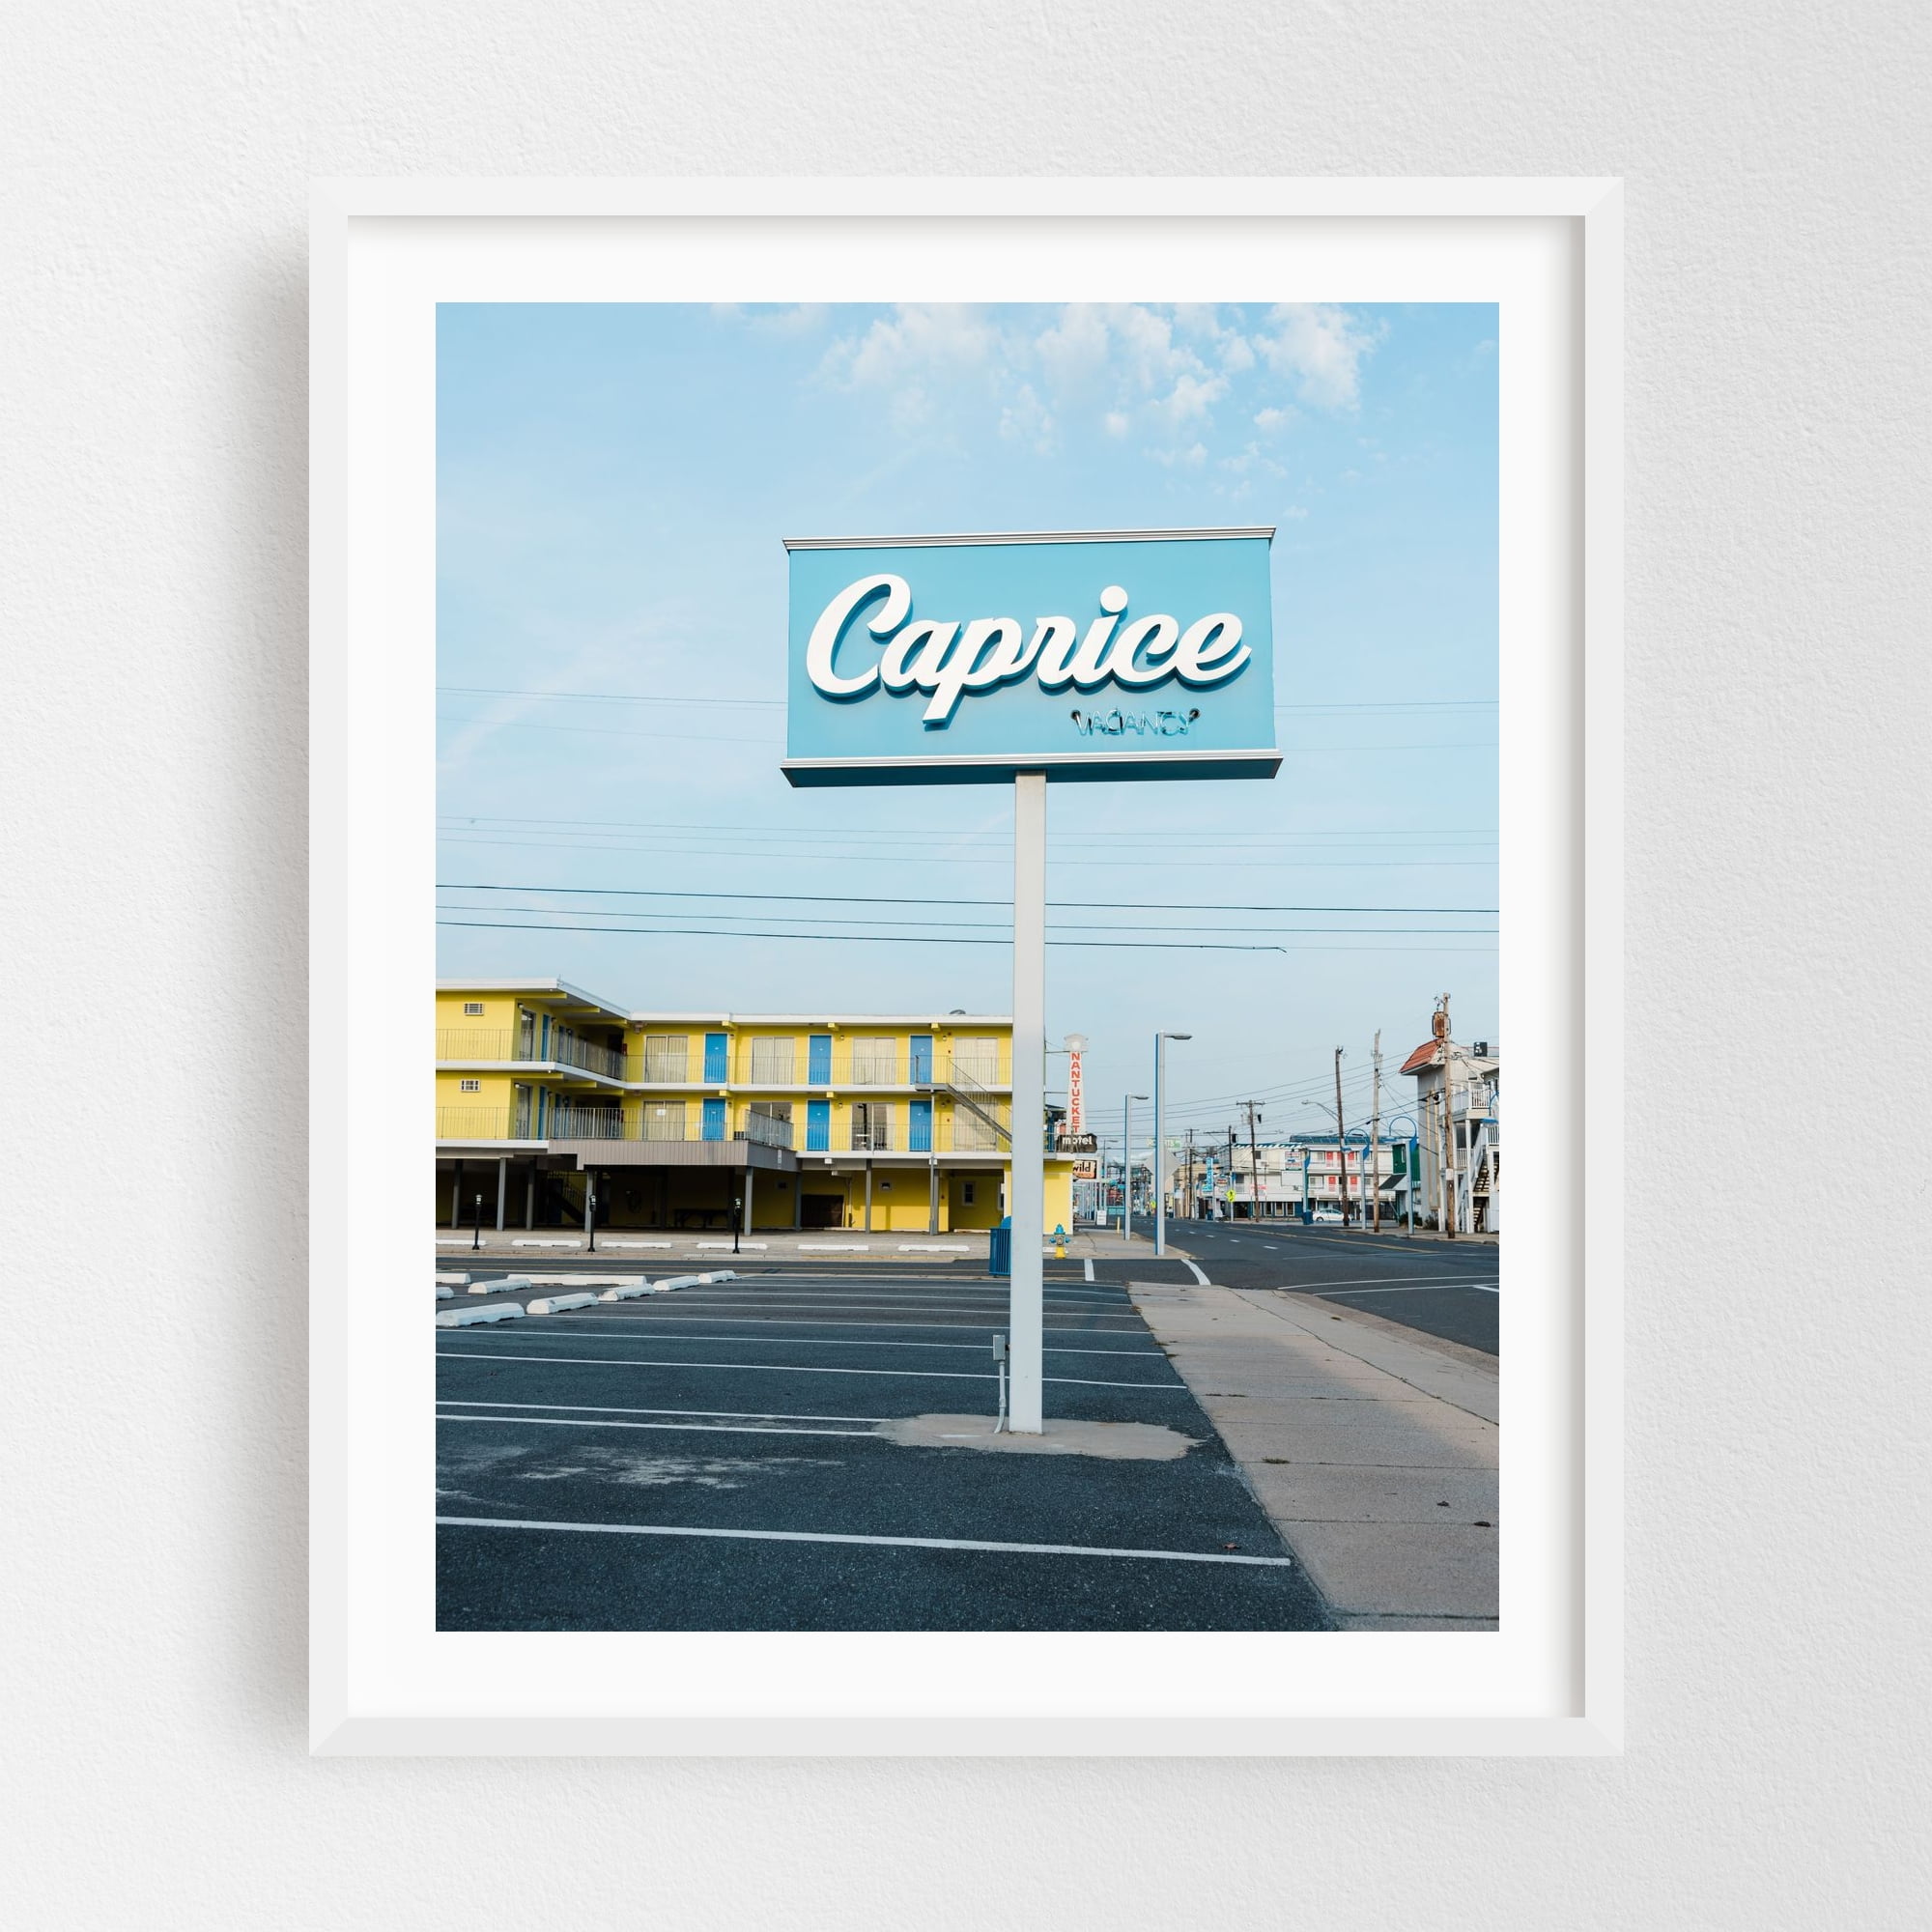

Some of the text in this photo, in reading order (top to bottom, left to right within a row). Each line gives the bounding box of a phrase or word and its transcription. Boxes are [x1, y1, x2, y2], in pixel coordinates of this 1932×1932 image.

[807, 574, 1253, 725] Caprice
[1073, 709, 1194, 736] VACANCY
[1071, 1053, 1081, 1133] NANTUCKET
[1063, 1135, 1093, 1145] motel
